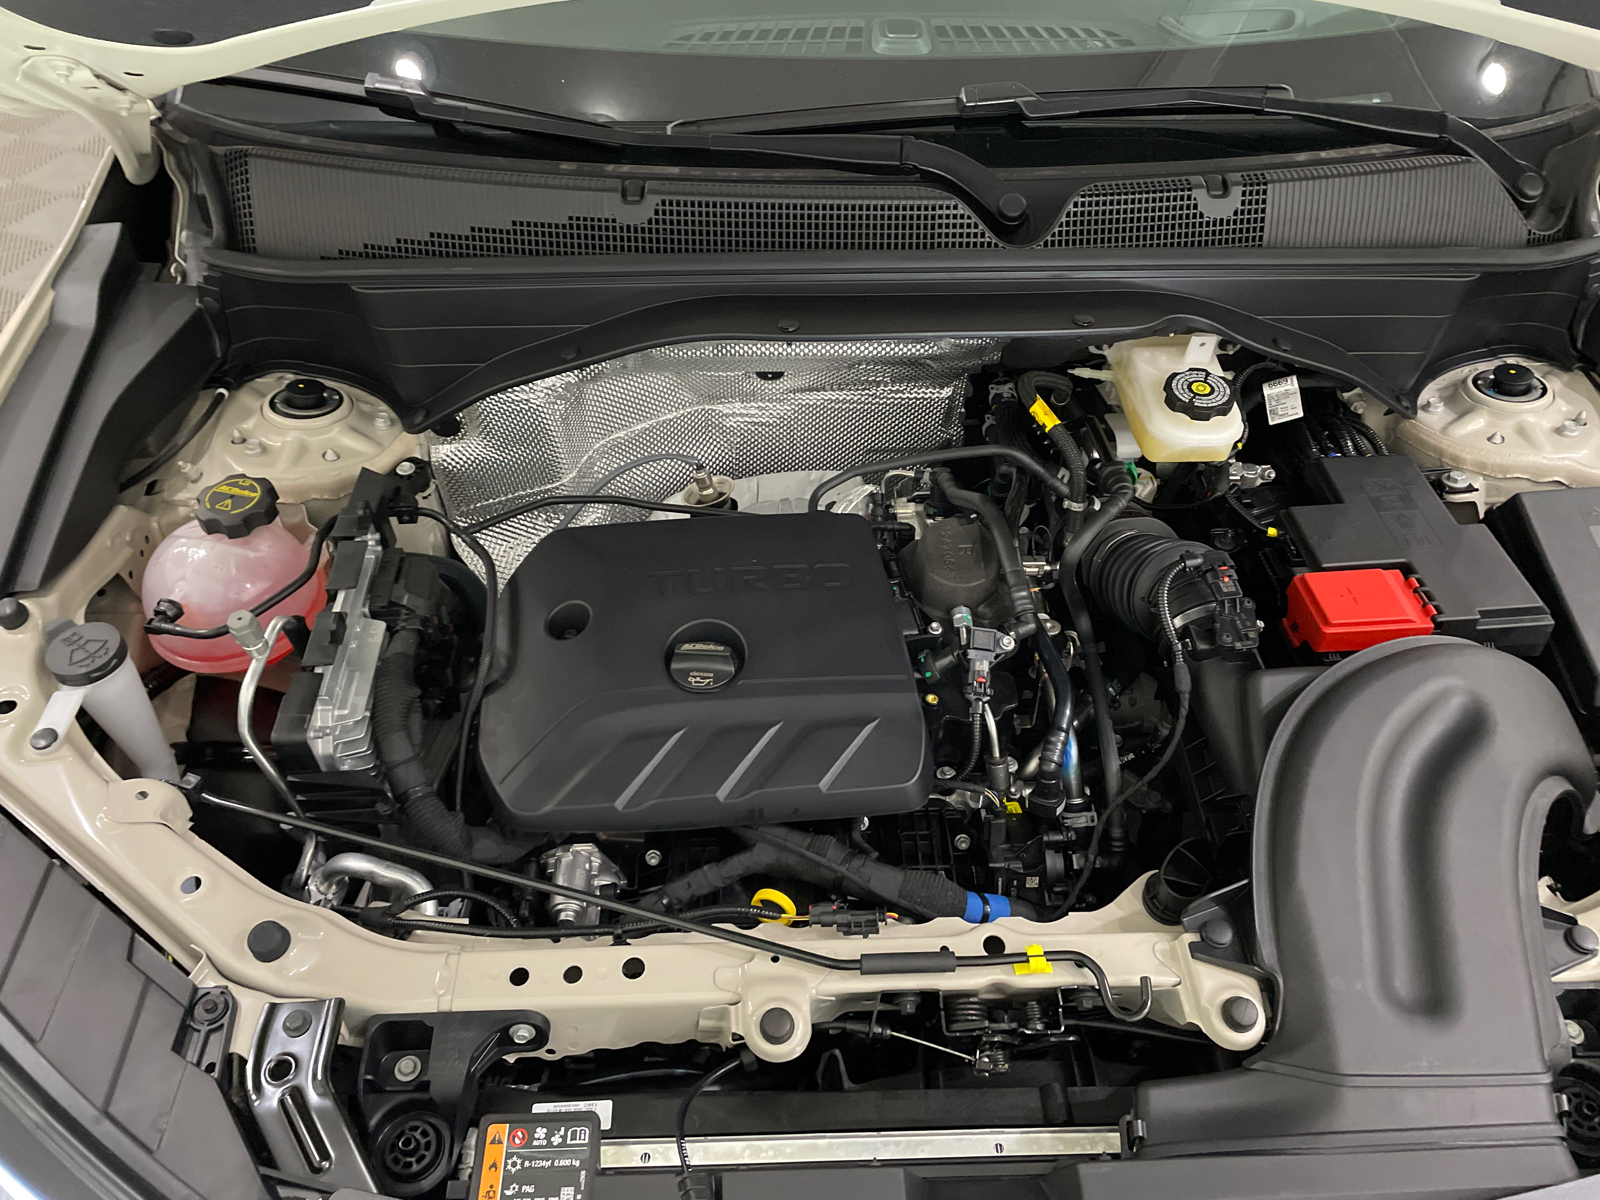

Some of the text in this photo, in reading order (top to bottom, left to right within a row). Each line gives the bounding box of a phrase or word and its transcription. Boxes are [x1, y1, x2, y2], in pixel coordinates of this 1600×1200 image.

[648, 563, 850, 596] TURBO
[681, 643, 724, 651] ACDelco
[524, 1159, 580, 1168] R-1234yf 0.600 kg
[522, 1185, 535, 1193] PAG
